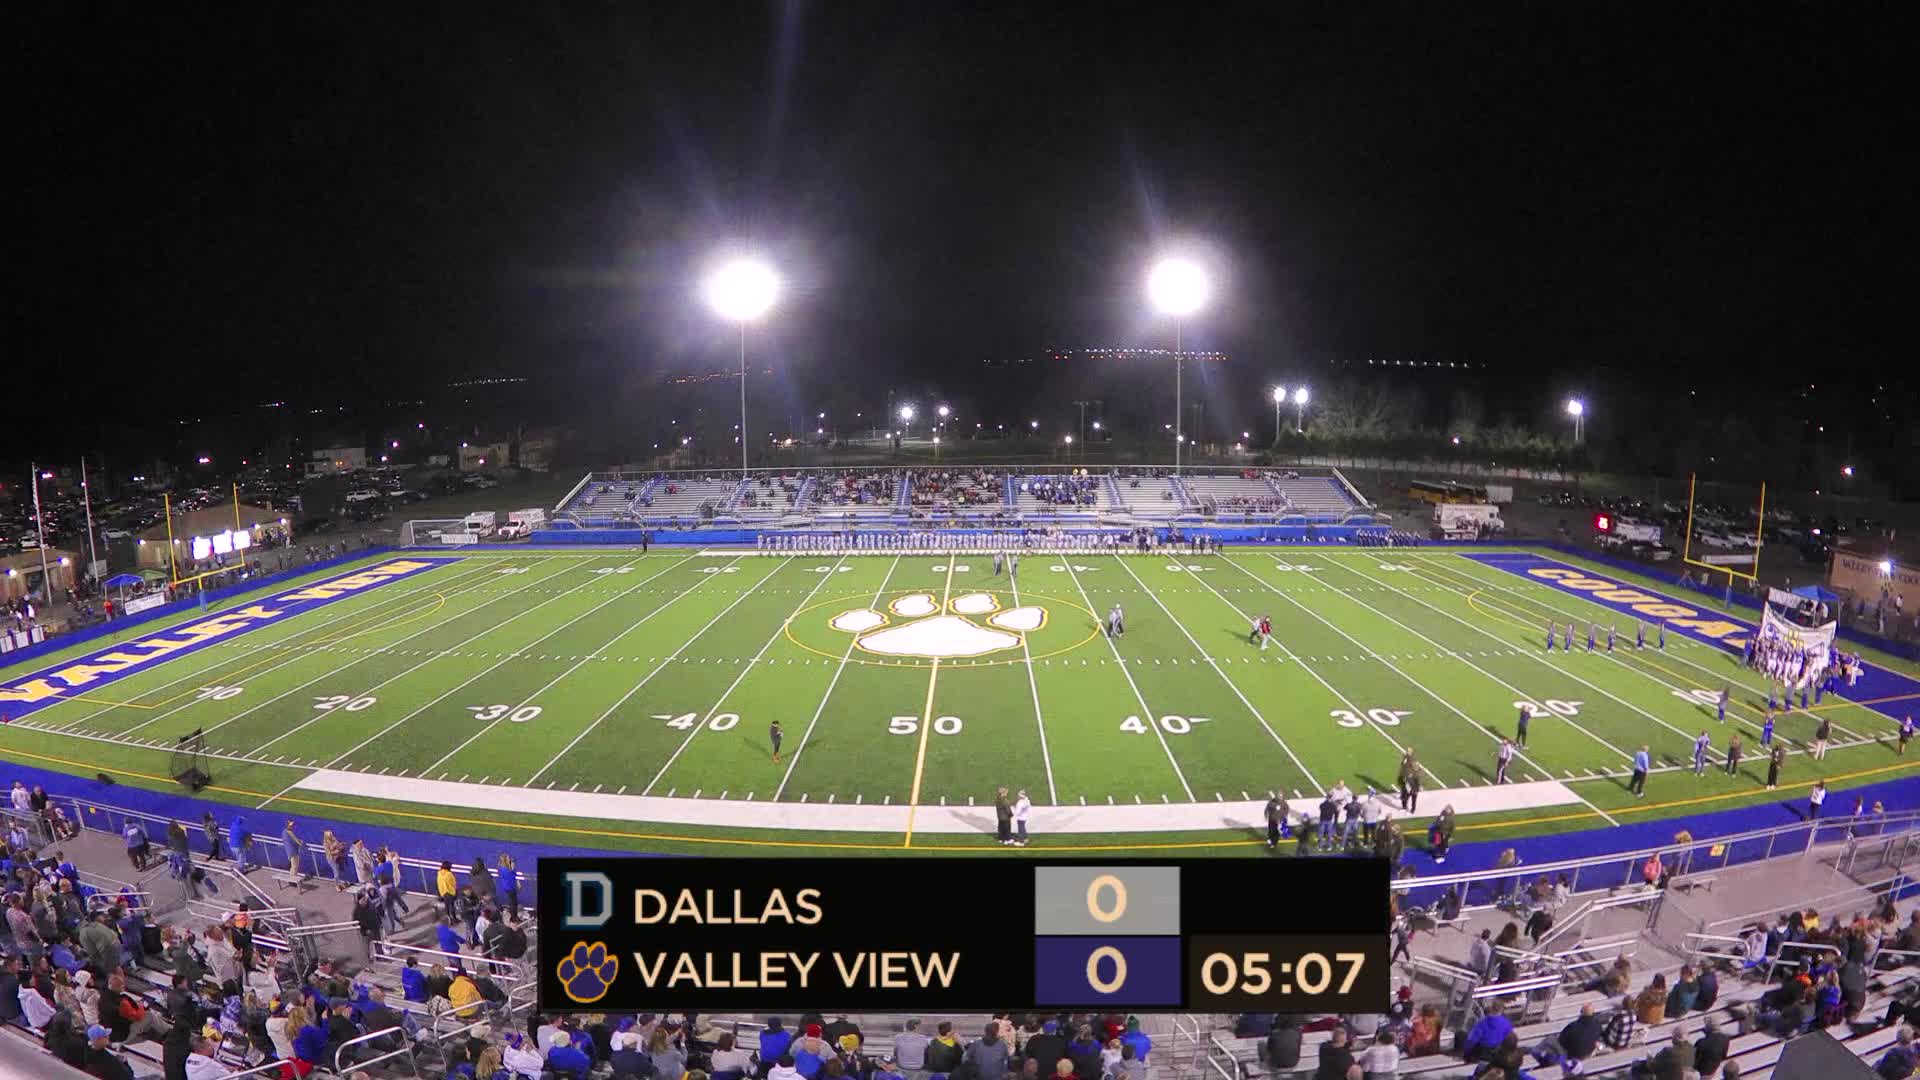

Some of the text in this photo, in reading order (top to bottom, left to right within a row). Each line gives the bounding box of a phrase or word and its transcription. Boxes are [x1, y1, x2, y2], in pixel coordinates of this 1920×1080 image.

[0, 560, 433, 703] VALLEY VIEW
[195, 686, 244, 700] 10
[313, 695, 377, 711] 20
[1513, 699, 1579, 718] 20
[474, 704, 542, 722] 30
[667, 712, 740, 731] 40
[1330, 708, 1401, 728] 30
[888, 715, 963, 735] 50
[1120, 715, 1191, 735] 40
